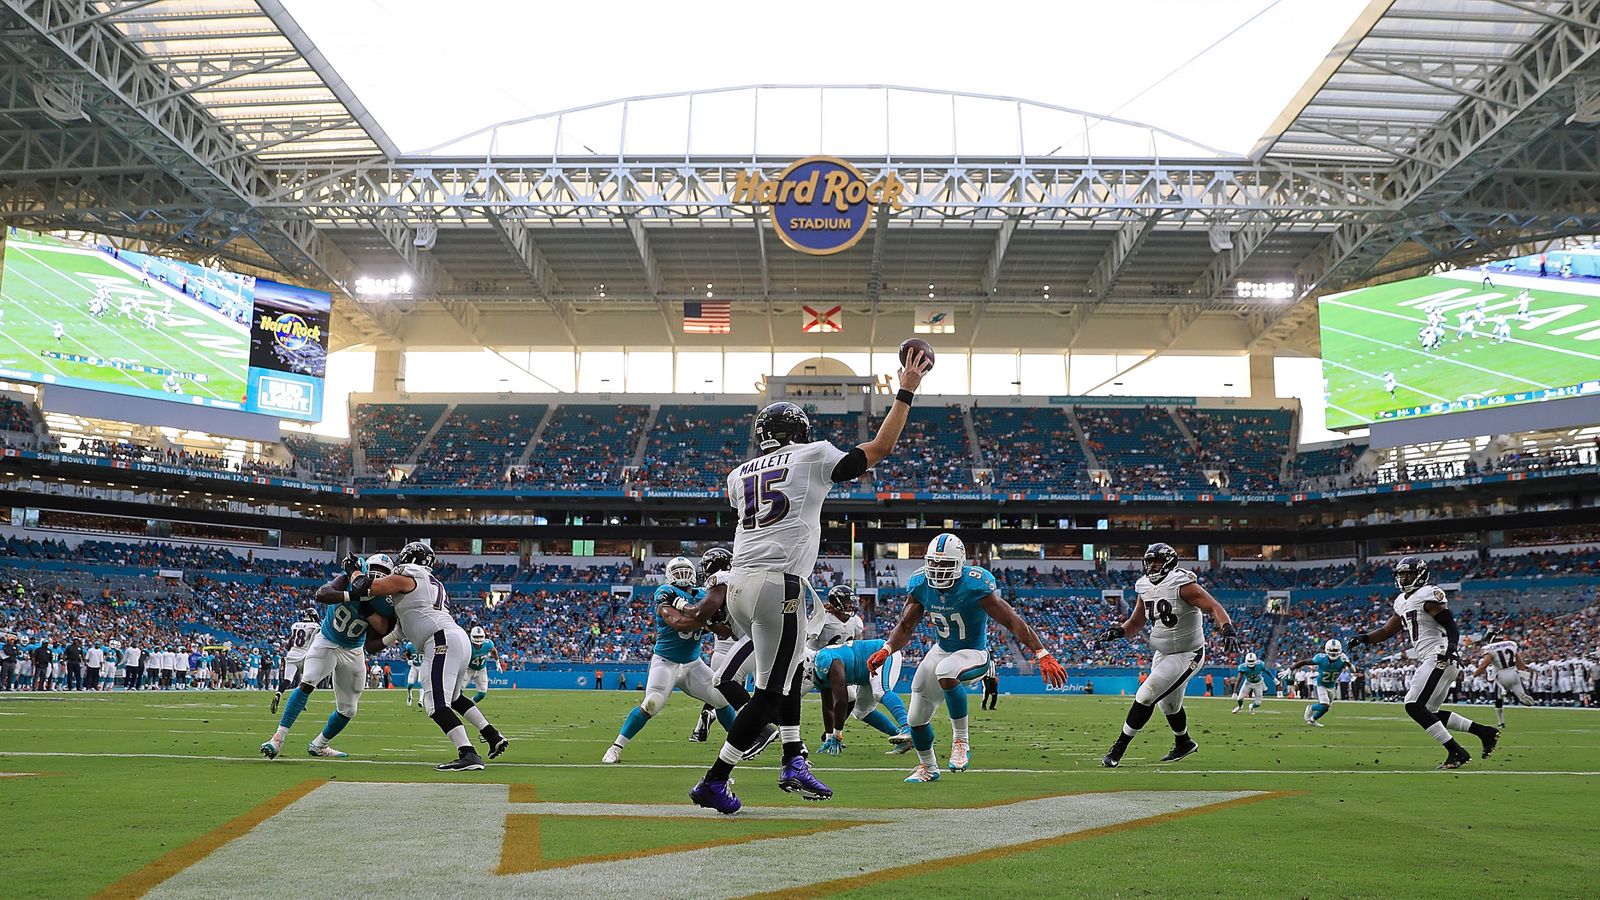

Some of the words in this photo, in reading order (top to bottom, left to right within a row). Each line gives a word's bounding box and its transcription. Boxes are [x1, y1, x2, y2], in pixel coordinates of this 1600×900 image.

[732, 170, 819, 204] Hard
[822, 169, 904, 212] Rock
[790, 218, 851, 231] STADIUM
[260, 315, 294, 334] Hard
[293, 321, 321, 342] Rock
[270, 381, 304, 399] BUD
[262, 391, 309, 410] LIGHT
[1488, 396, 1507, 405] 6:26
[37, 453, 60, 461] SUPER
[62, 456, 83, 464] BOWL
[740, 452, 793, 477] MALLETT
[137, 464, 157, 473] 1972
[159, 466, 184, 476] PERFECT
[186, 469, 212, 478] SEASON
[214, 472, 231, 480] TEAM
[233, 474, 249, 482] 17-0
[282, 481, 300, 489] SUPER
[742, 467, 790, 530] 15
[333, 605, 369, 638] 90
[1145, 599, 1178, 628] 78
[930, 612, 966, 640] 91
[293, 629, 306, 647] 18
[412, 653, 425, 663] 20
[472, 656, 486, 666] 47
[1496, 648, 1516, 669] 12
